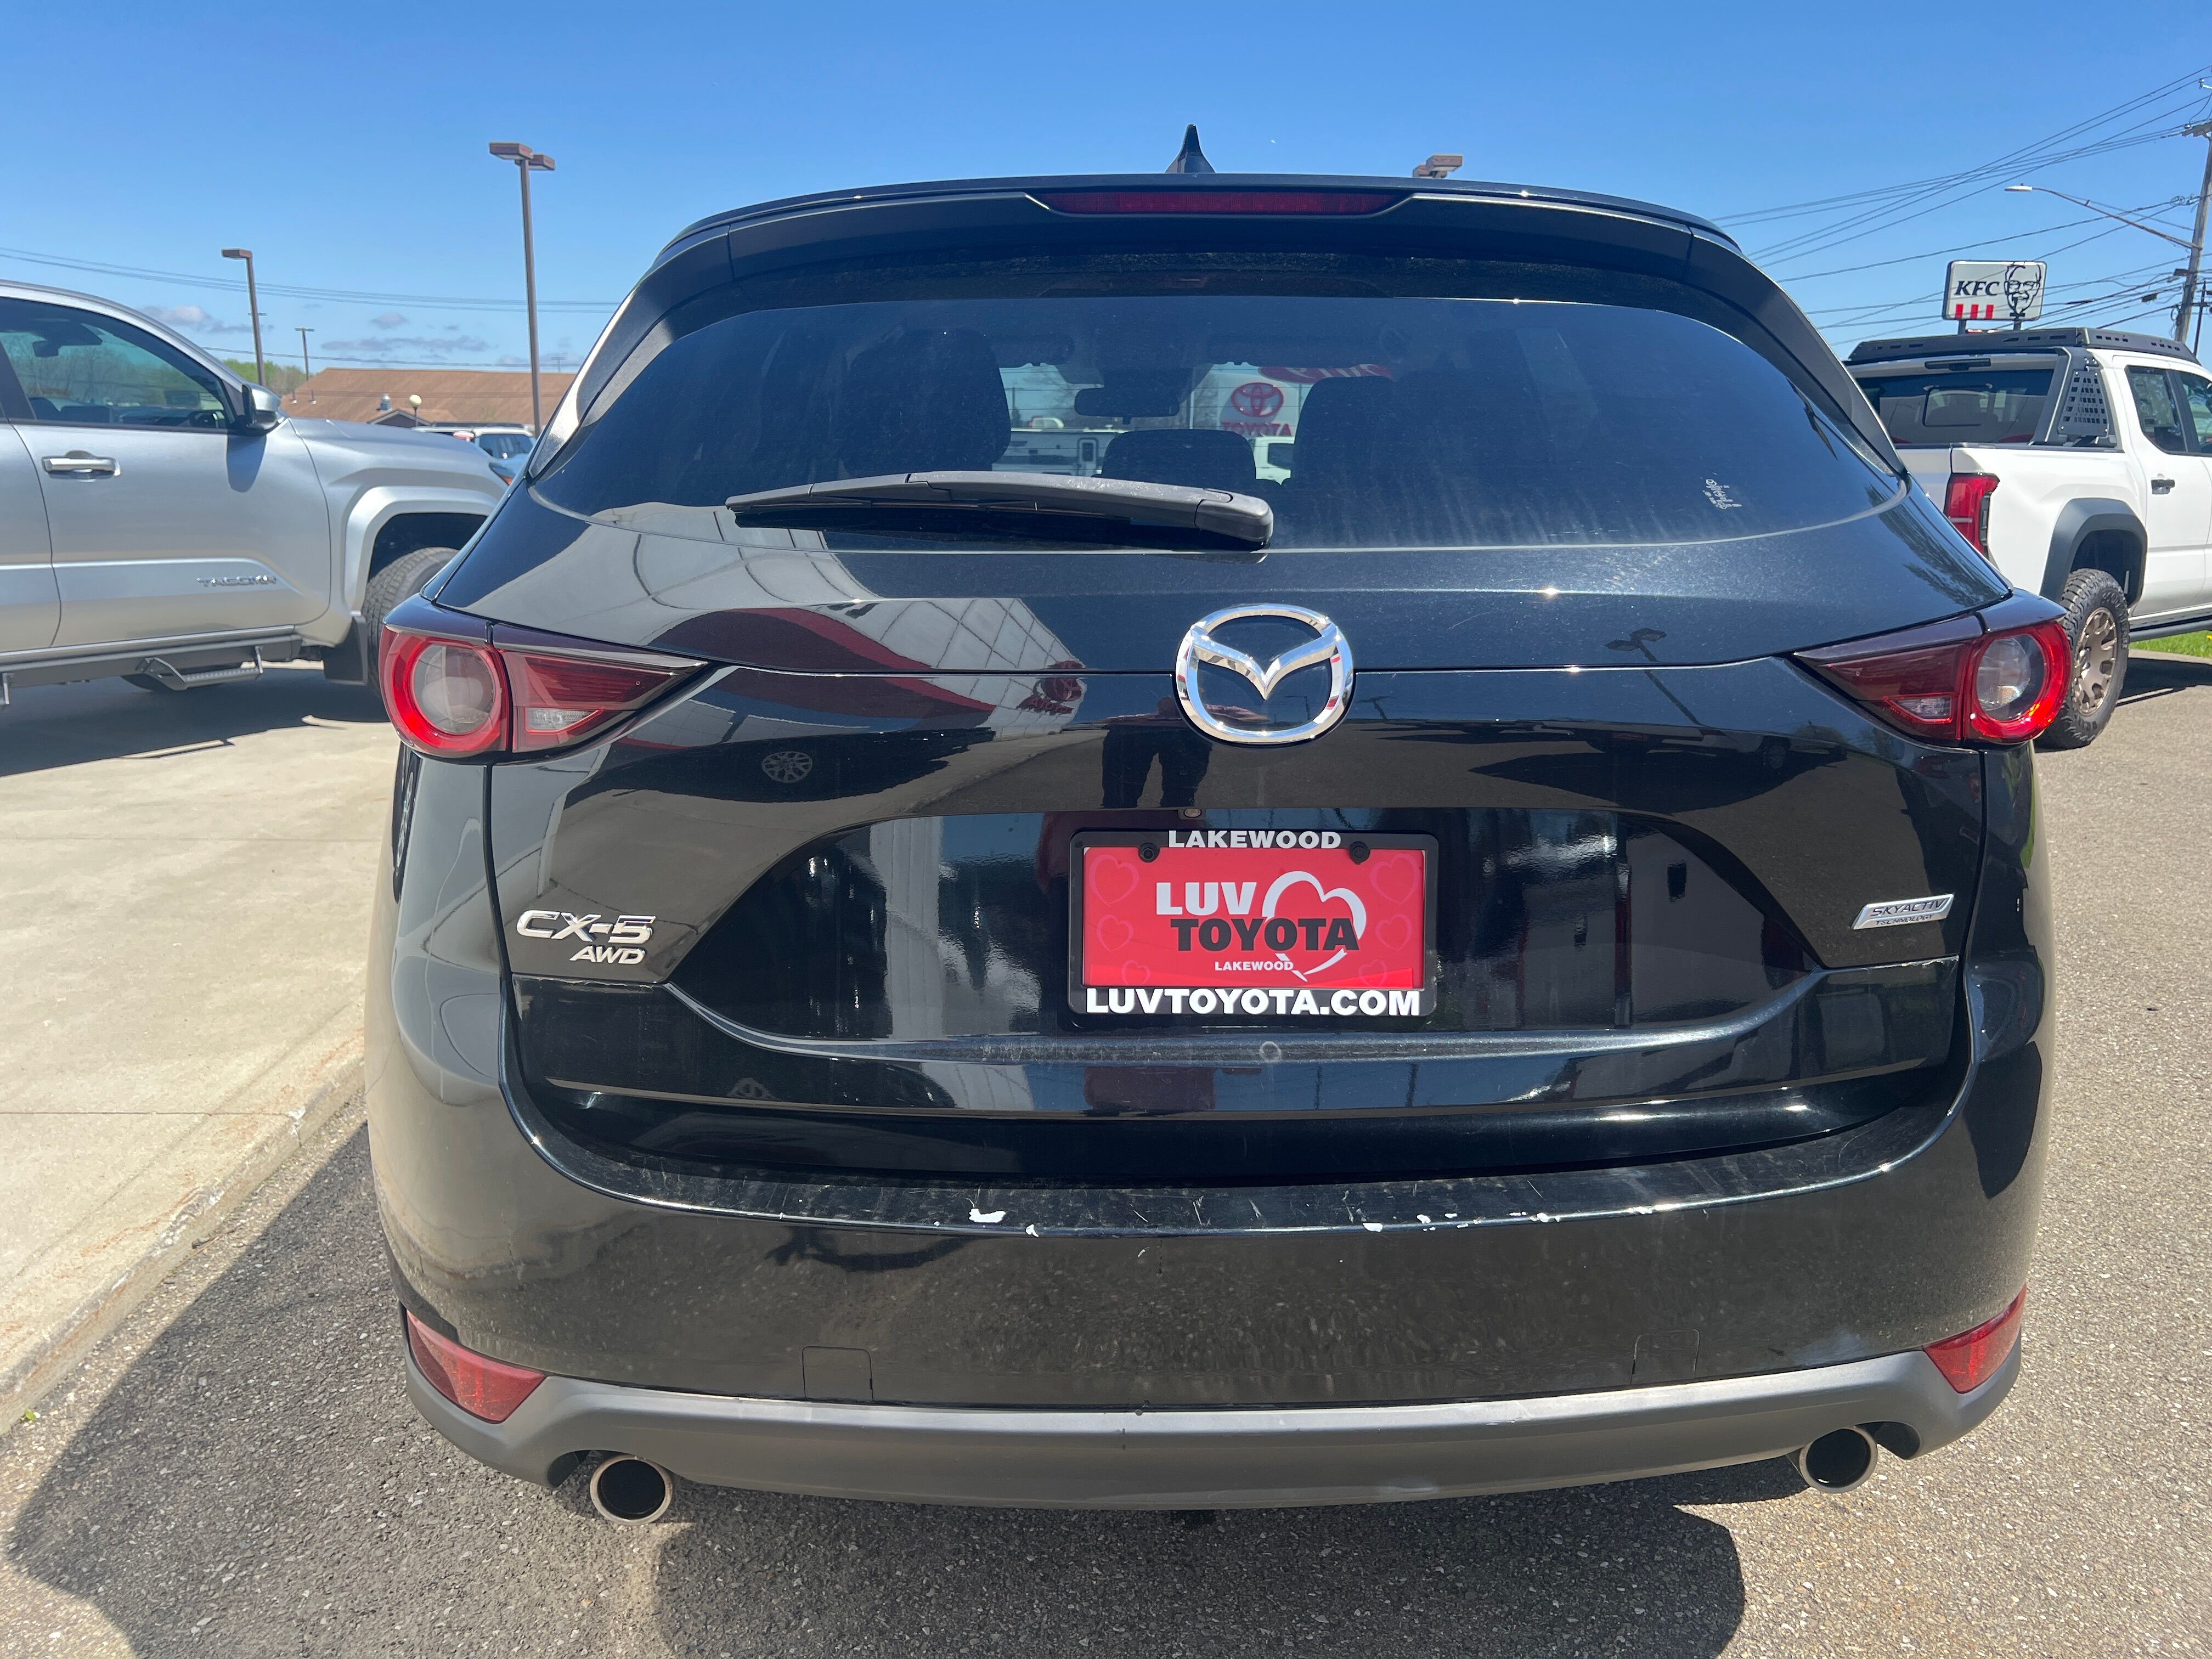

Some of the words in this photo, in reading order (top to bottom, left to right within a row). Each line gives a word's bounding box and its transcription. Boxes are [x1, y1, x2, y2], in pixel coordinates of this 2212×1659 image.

[1954, 281, 2000, 296] KFC
[1169, 830, 1341, 849] LAKEWOOD
[1156, 882, 1257, 916] LUV
[1871, 899, 1949, 917] SKYACTIV
[516, 910, 656, 944] CX-5
[1876, 914, 1933, 926] TECHNOLOGY
[1170, 918, 1359, 951] TOYOTA
[569, 945, 647, 964] AWD
[1215, 961, 1294, 971] LAKEWOOD
[1086, 988, 1420, 1016] LUVTOYOTA.COM
